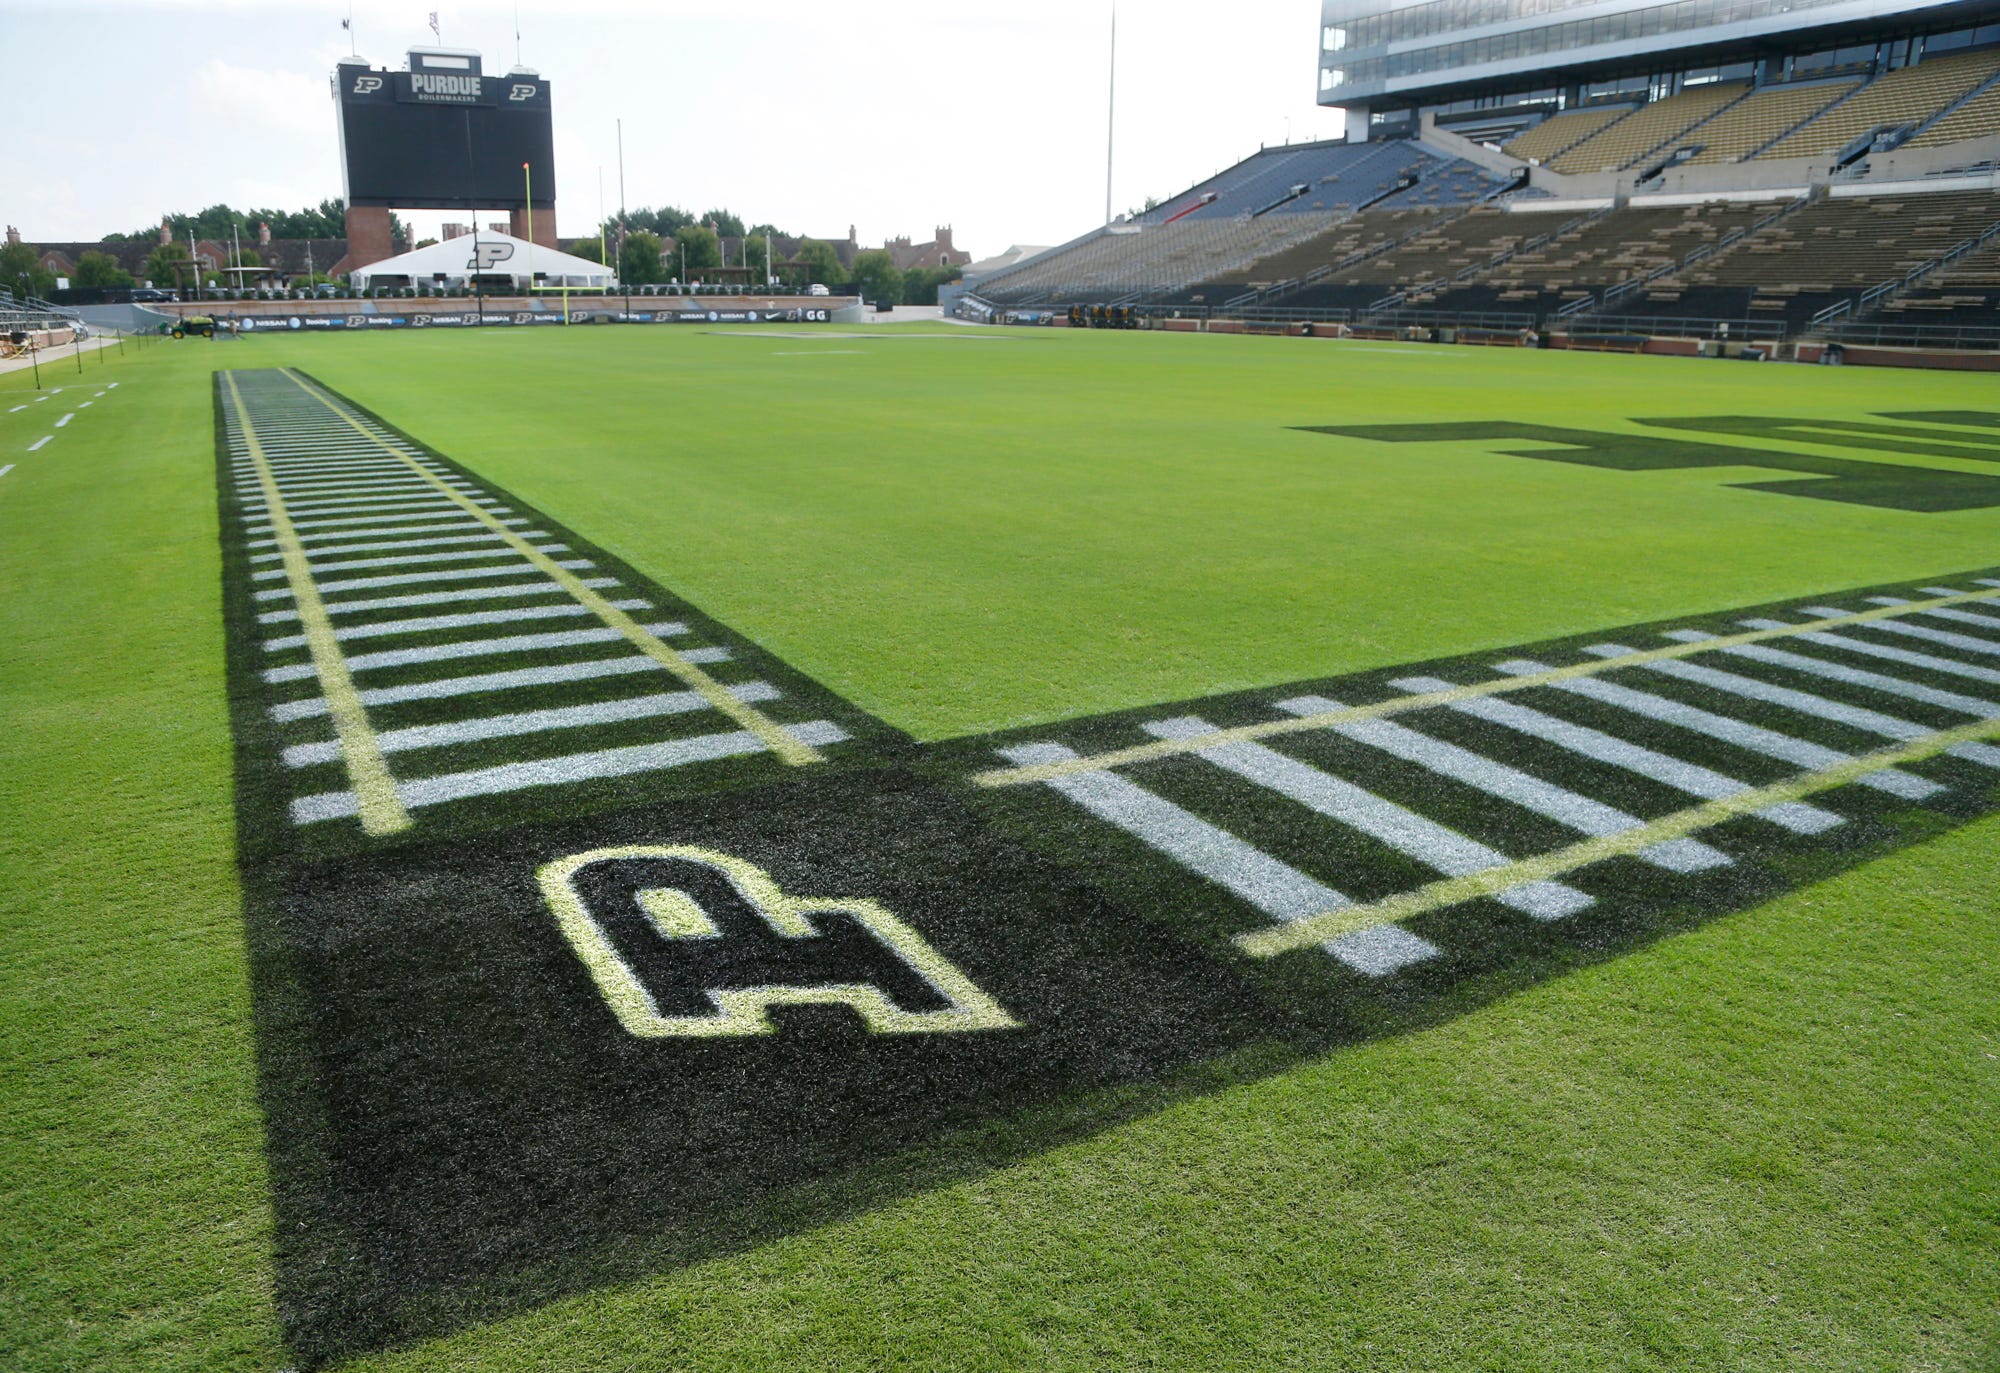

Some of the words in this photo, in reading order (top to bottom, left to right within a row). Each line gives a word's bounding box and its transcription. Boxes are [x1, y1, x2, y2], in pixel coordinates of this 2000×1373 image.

[354, 76, 383, 94] P
[411, 74, 482, 95] PURDUE
[509, 84, 536, 100] P
[418, 93, 476, 102] BOILERMAKERS
[466, 242, 514, 269] P
